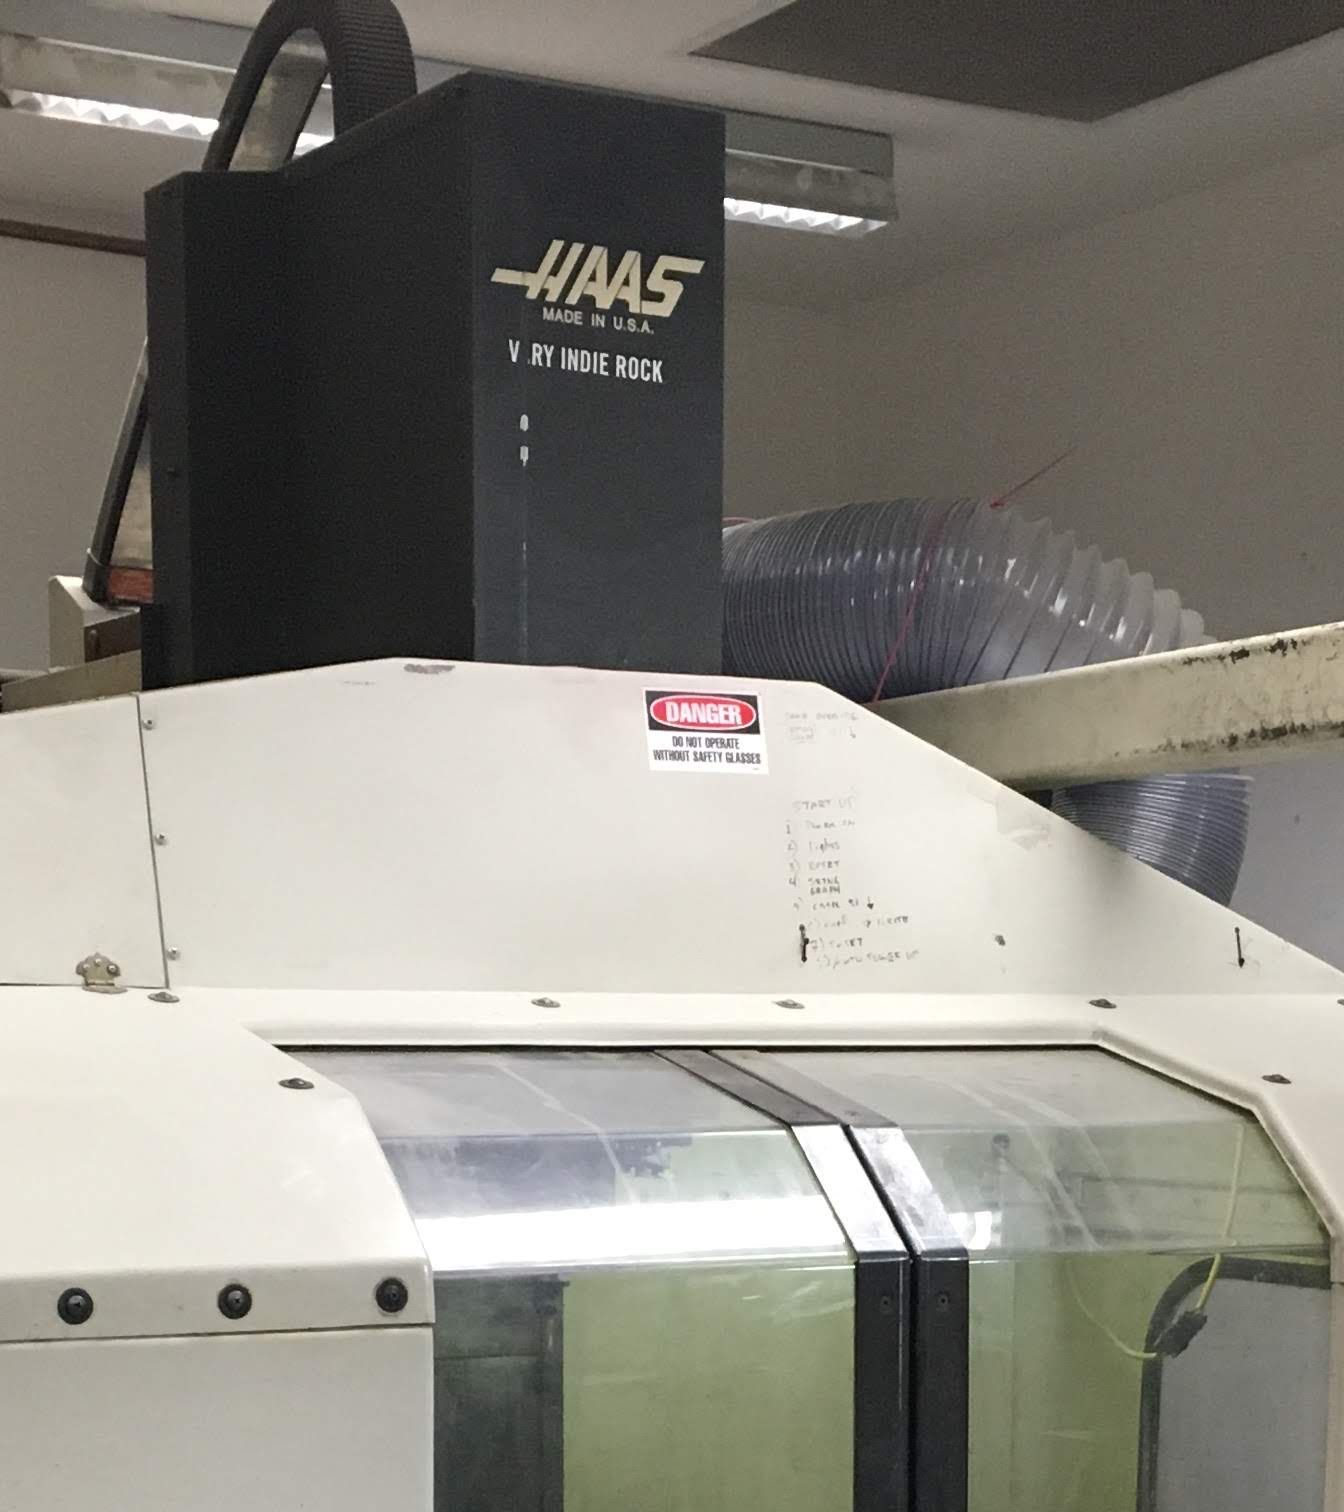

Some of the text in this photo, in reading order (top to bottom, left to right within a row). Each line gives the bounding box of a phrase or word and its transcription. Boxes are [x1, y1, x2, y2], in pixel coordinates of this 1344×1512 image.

[490, 239, 705, 318] HAAS
[542, 306, 655, 335] MADE IN U.S.A.
[560, 346, 610, 377] INDIE
[615, 354, 664, 384] ROCK
[665, 700, 743, 726] DANGER
[672, 735, 740, 750] DO NOT OPERATE
[653, 749, 761, 765] WITHOUT SAFETY GLASSES
